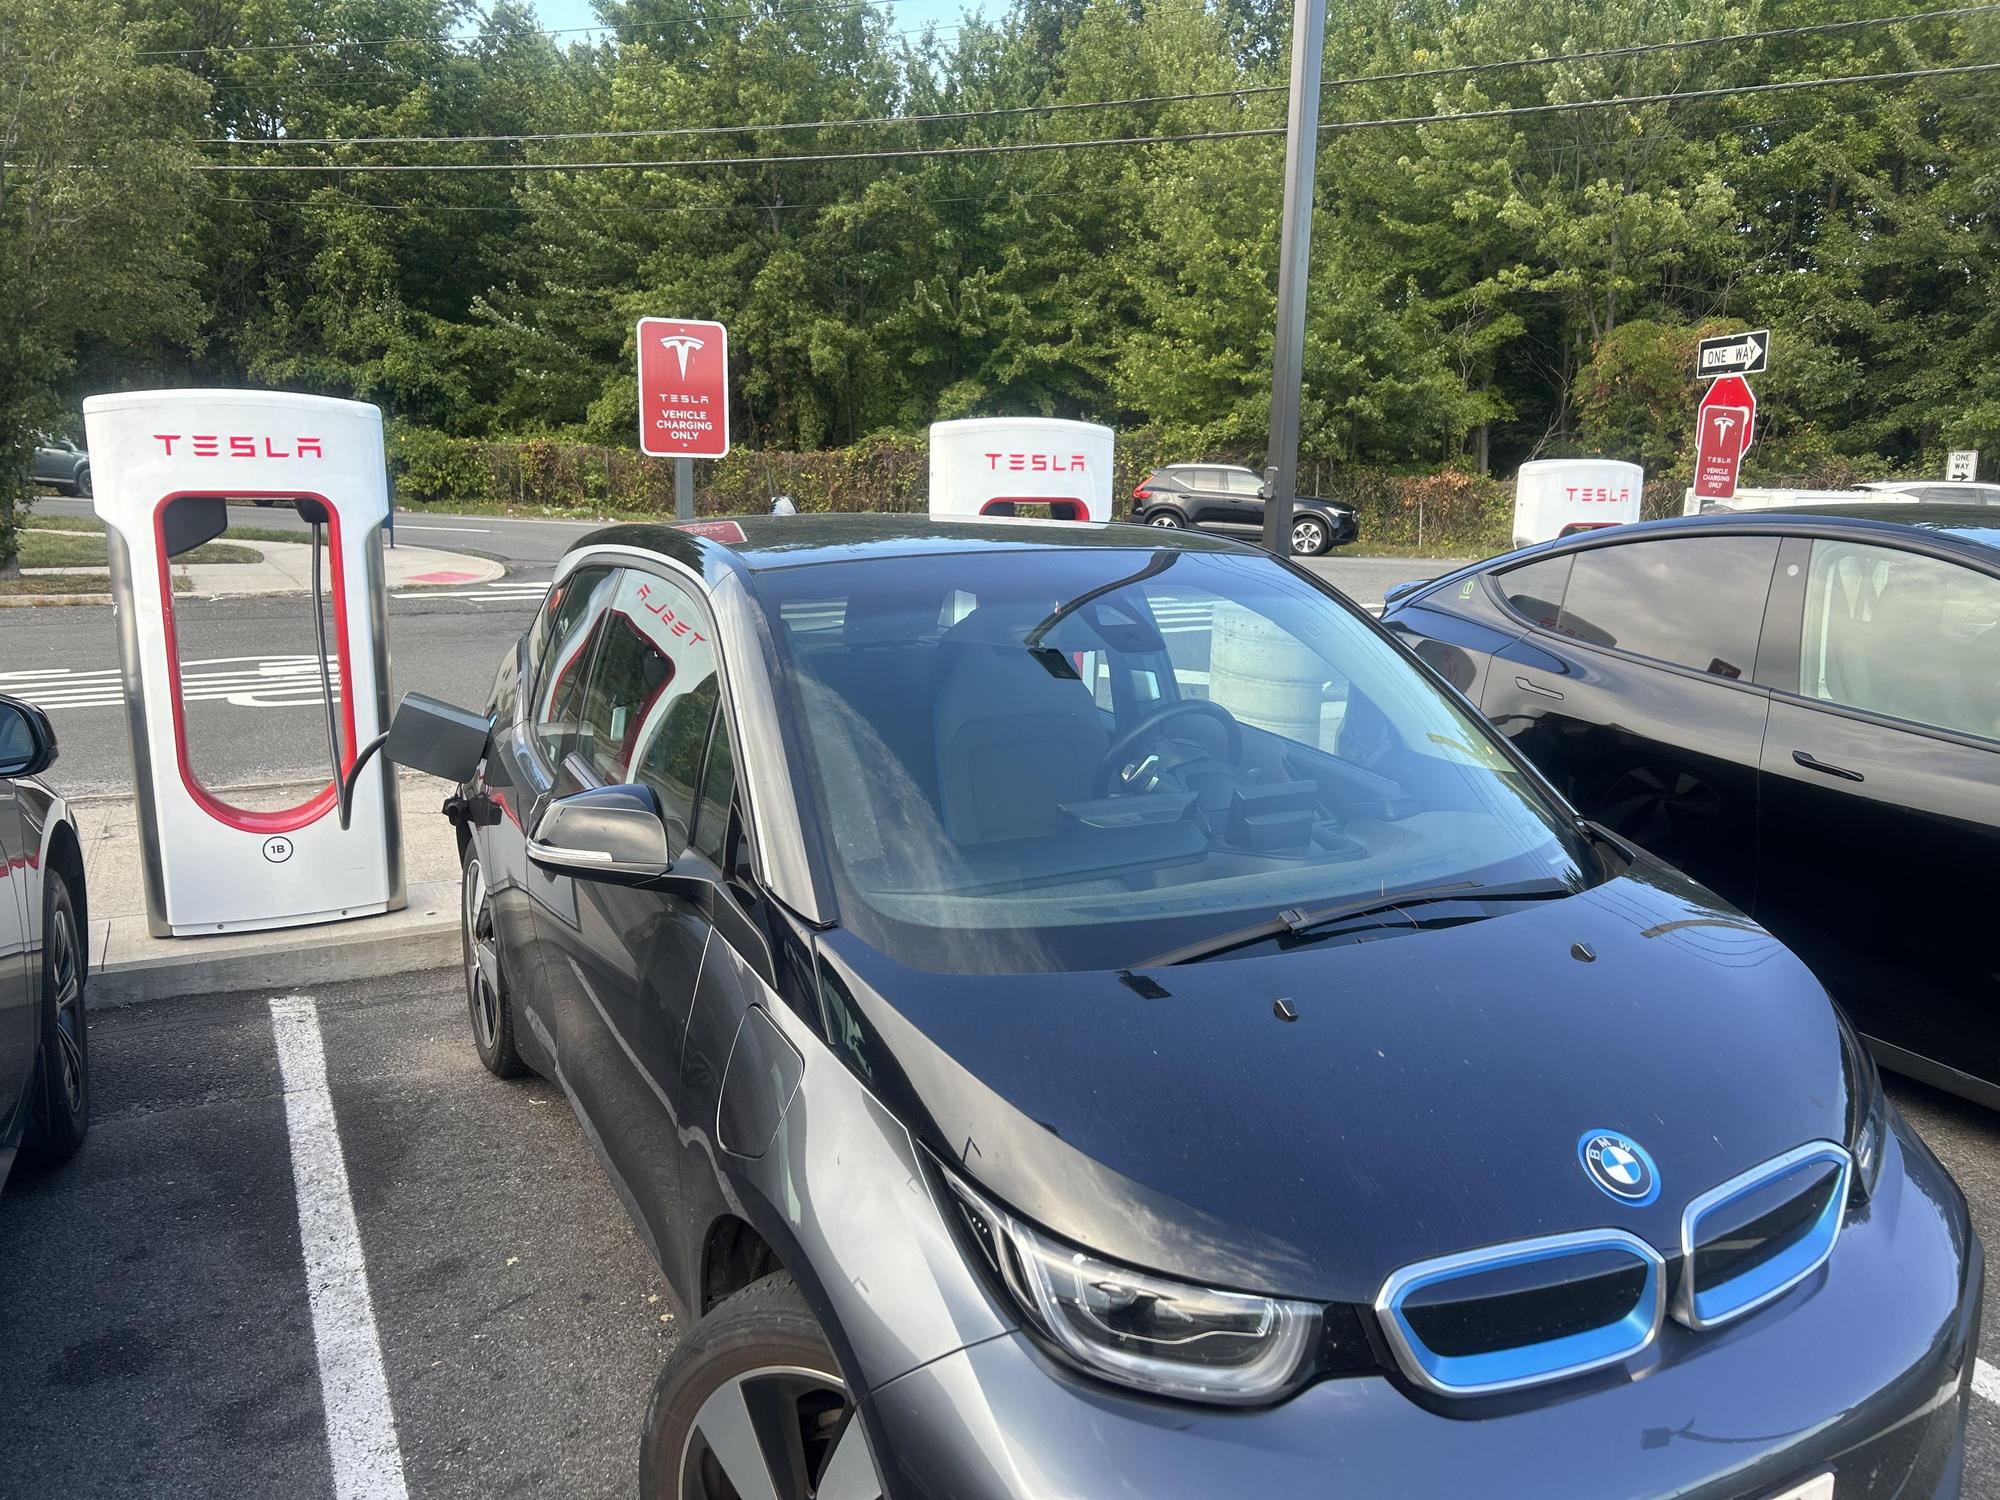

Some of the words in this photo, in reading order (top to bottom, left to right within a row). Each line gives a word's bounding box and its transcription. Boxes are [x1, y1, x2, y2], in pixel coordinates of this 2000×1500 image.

[1707, 349, 1727, 365] ONE
[1735, 345, 1756, 361] WAY
[659, 393, 709, 404] TESLA
[661, 409, 707, 420] VEHICLE
[656, 419, 713, 431] CHARGING
[670, 431, 699, 441] ONLY
[152, 434, 322, 459] TESLA
[984, 453, 1085, 472] TESLA
[1707, 456, 1731, 464] TESLA
[1955, 453, 1971, 462] ONE
[1706, 467, 1728, 475] VEHICLE
[1954, 462, 1970, 470] WAY
[1702, 474, 1730, 482] CHARGING
[1566, 488, 1629, 502] TESLA
[270, 844, 286, 854] 1B
[1588, 1136, 1632, 1161] BMW
